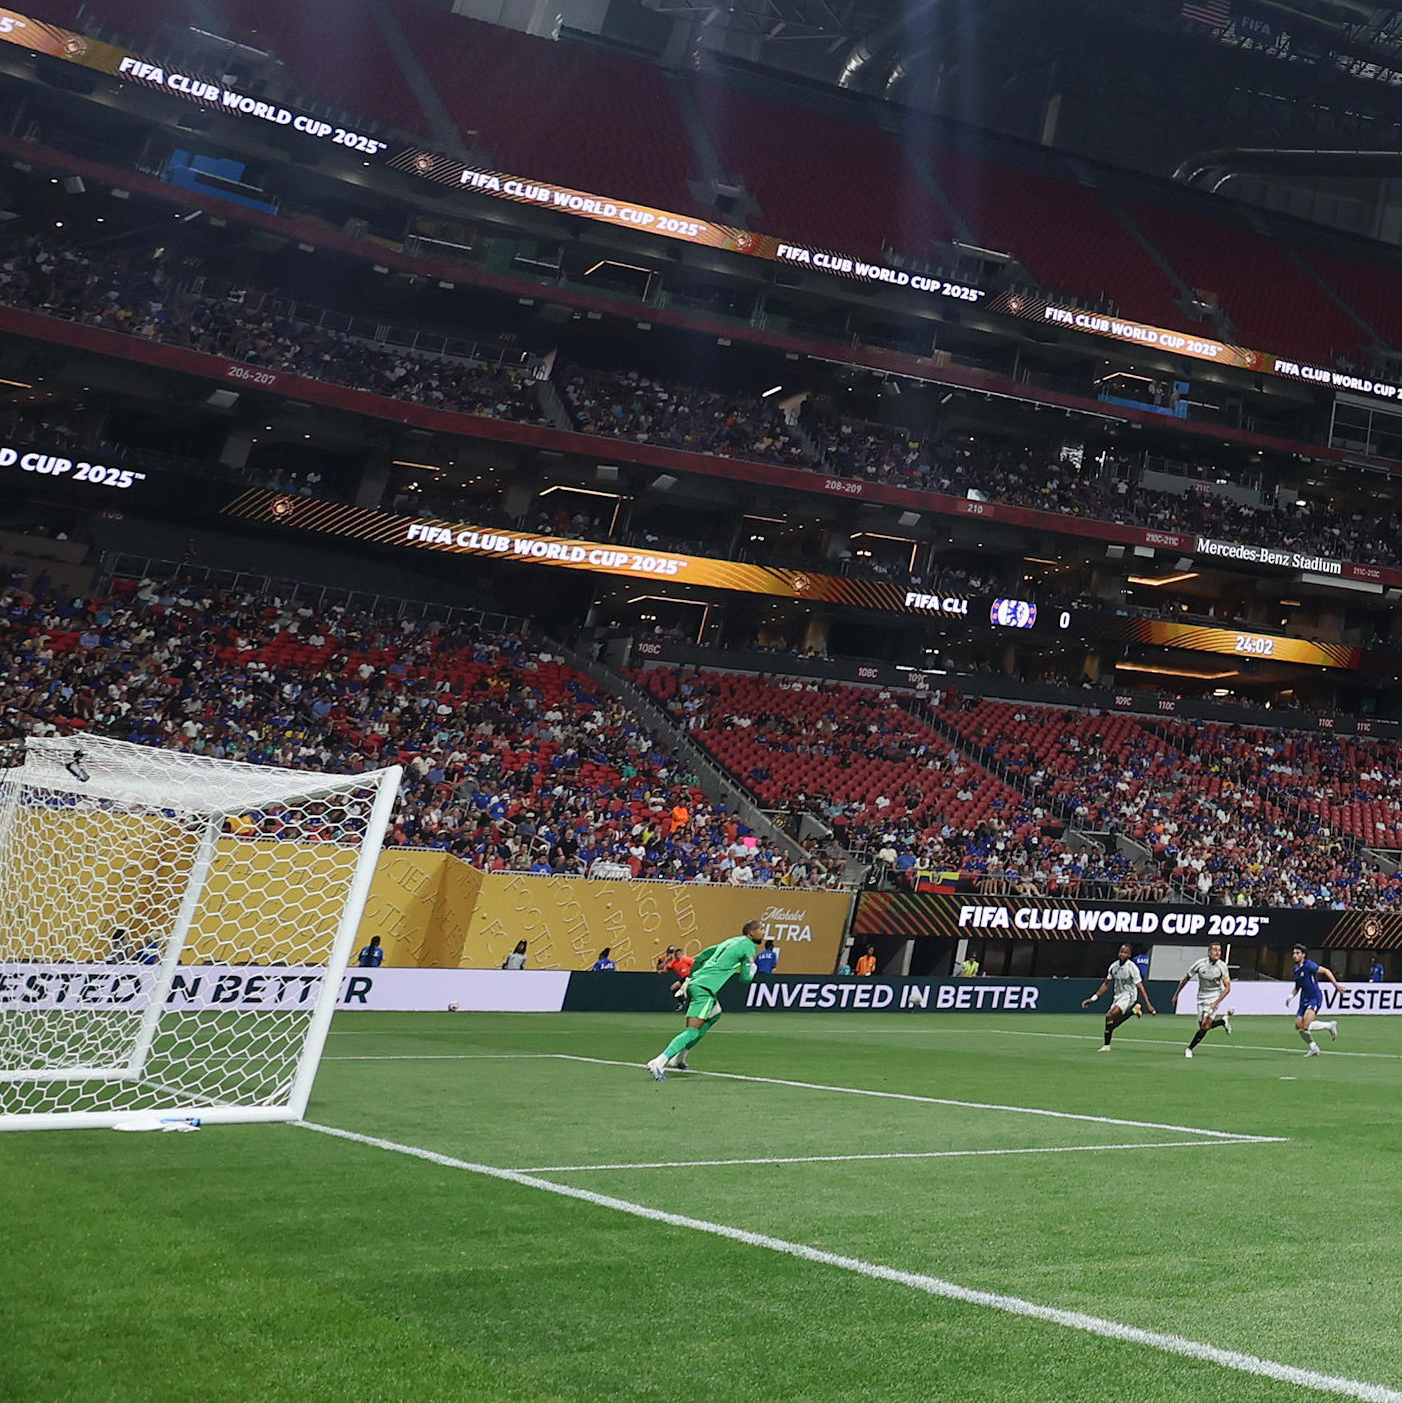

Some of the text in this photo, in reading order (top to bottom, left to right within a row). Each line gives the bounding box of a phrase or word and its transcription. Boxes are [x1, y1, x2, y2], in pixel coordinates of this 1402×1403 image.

[119, 57, 162, 83] FIFA
[167, 74, 219, 100] CLUB
[223, 91, 291, 123] WORLD
[293, 116, 331, 136] CUP
[460, 170, 499, 190] FIFA
[503, 181, 549, 201] CLUB
[554, 192, 616, 216] WORLD
[619, 208, 654, 224] CUP
[776, 244, 809, 262] FIFA
[813, 253, 852, 271] CLUB
[855, 262, 908, 284] WORLD
[910, 276, 940, 291] CUP
[1045, 307, 1072, 323] FIFA
[1075, 314, 1108, 331] CLUB
[1111, 322, 1157, 342] WORLD
[1159, 334, 1185, 348] CUP
[228, 365, 276, 386] 206-207
[1274, 360, 1299, 375] FIFA
[1301, 366, 1330, 382] CLUB
[1332, 373, 1372, 391] WORLD
[1373, 383, 1395, 396] CUP
[20, 453, 71, 474] CUP
[824, 479, 862, 494] 208-209
[967, 503, 983, 514] 210
[407, 524, 451, 543] FIFA
[457, 531, 509, 550] CLUB
[514, 539, 585, 561] WORLD
[589, 550, 628, 566] CUP
[1197, 538, 1342, 575] Mercedes-Benz Stadium
[905, 592, 938, 609] FIFA
[1060, 612, 1070, 628] 0
[1235, 635, 1273, 655] 24:02
[1158, 700, 1175, 711] 110C
[959, 905, 1008, 927] FIFA
[1014, 908, 1073, 929] CLUB
[1079, 910, 1157, 932] WORLD
[1162, 913, 1204, 933] CUP
[759, 923, 812, 942] LTRA
[747, 983, 1038, 1008] INVESTED IN BETTER
